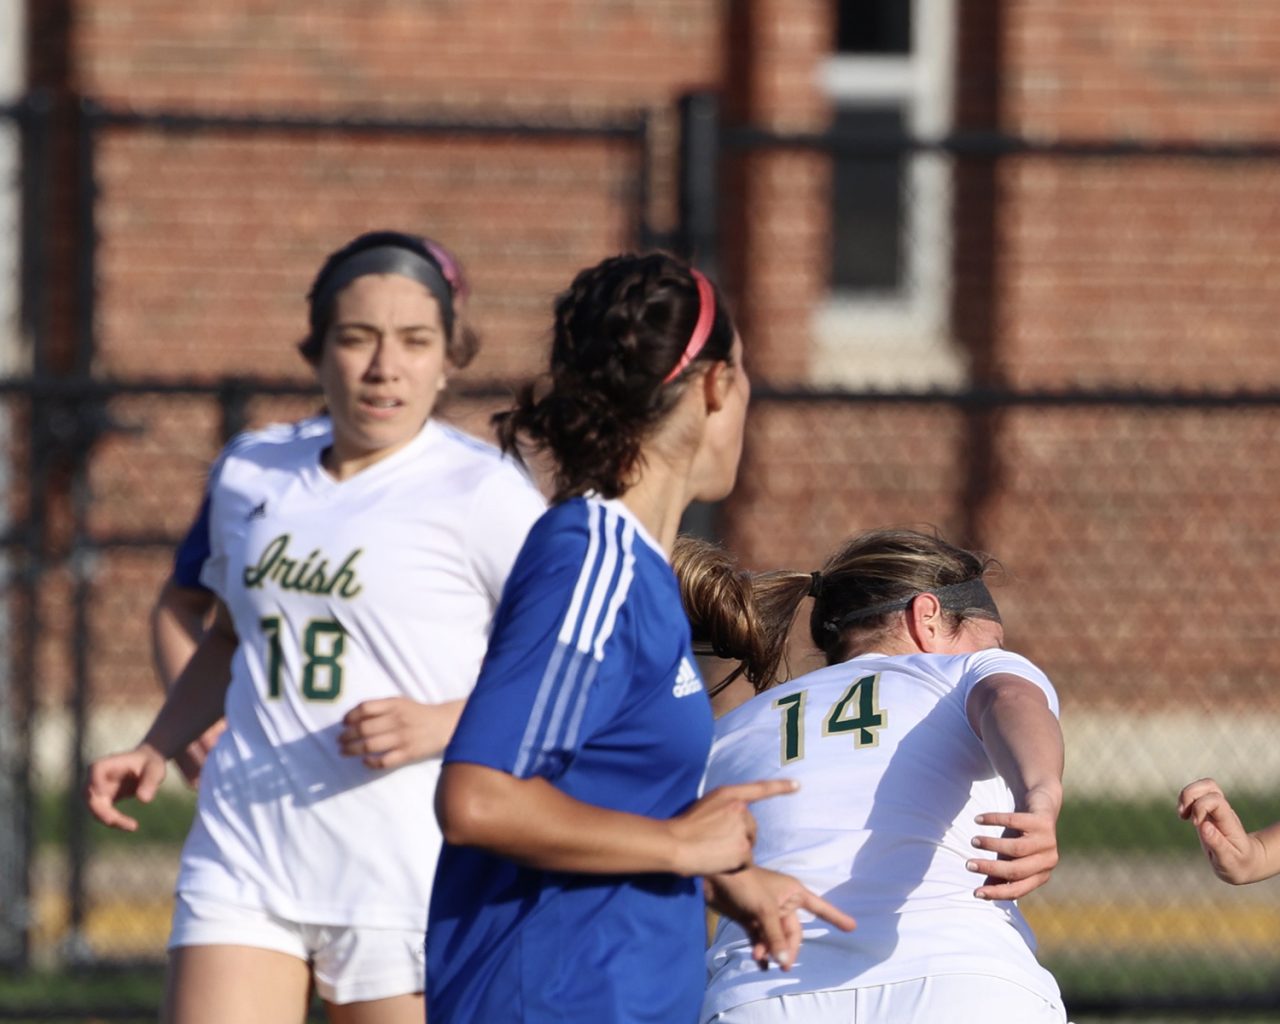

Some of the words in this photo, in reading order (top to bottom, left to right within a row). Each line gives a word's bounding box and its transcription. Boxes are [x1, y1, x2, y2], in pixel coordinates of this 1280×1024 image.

[243, 533, 362, 598] Irish
[260, 617, 345, 701] 18
[772, 672, 888, 767] 14
